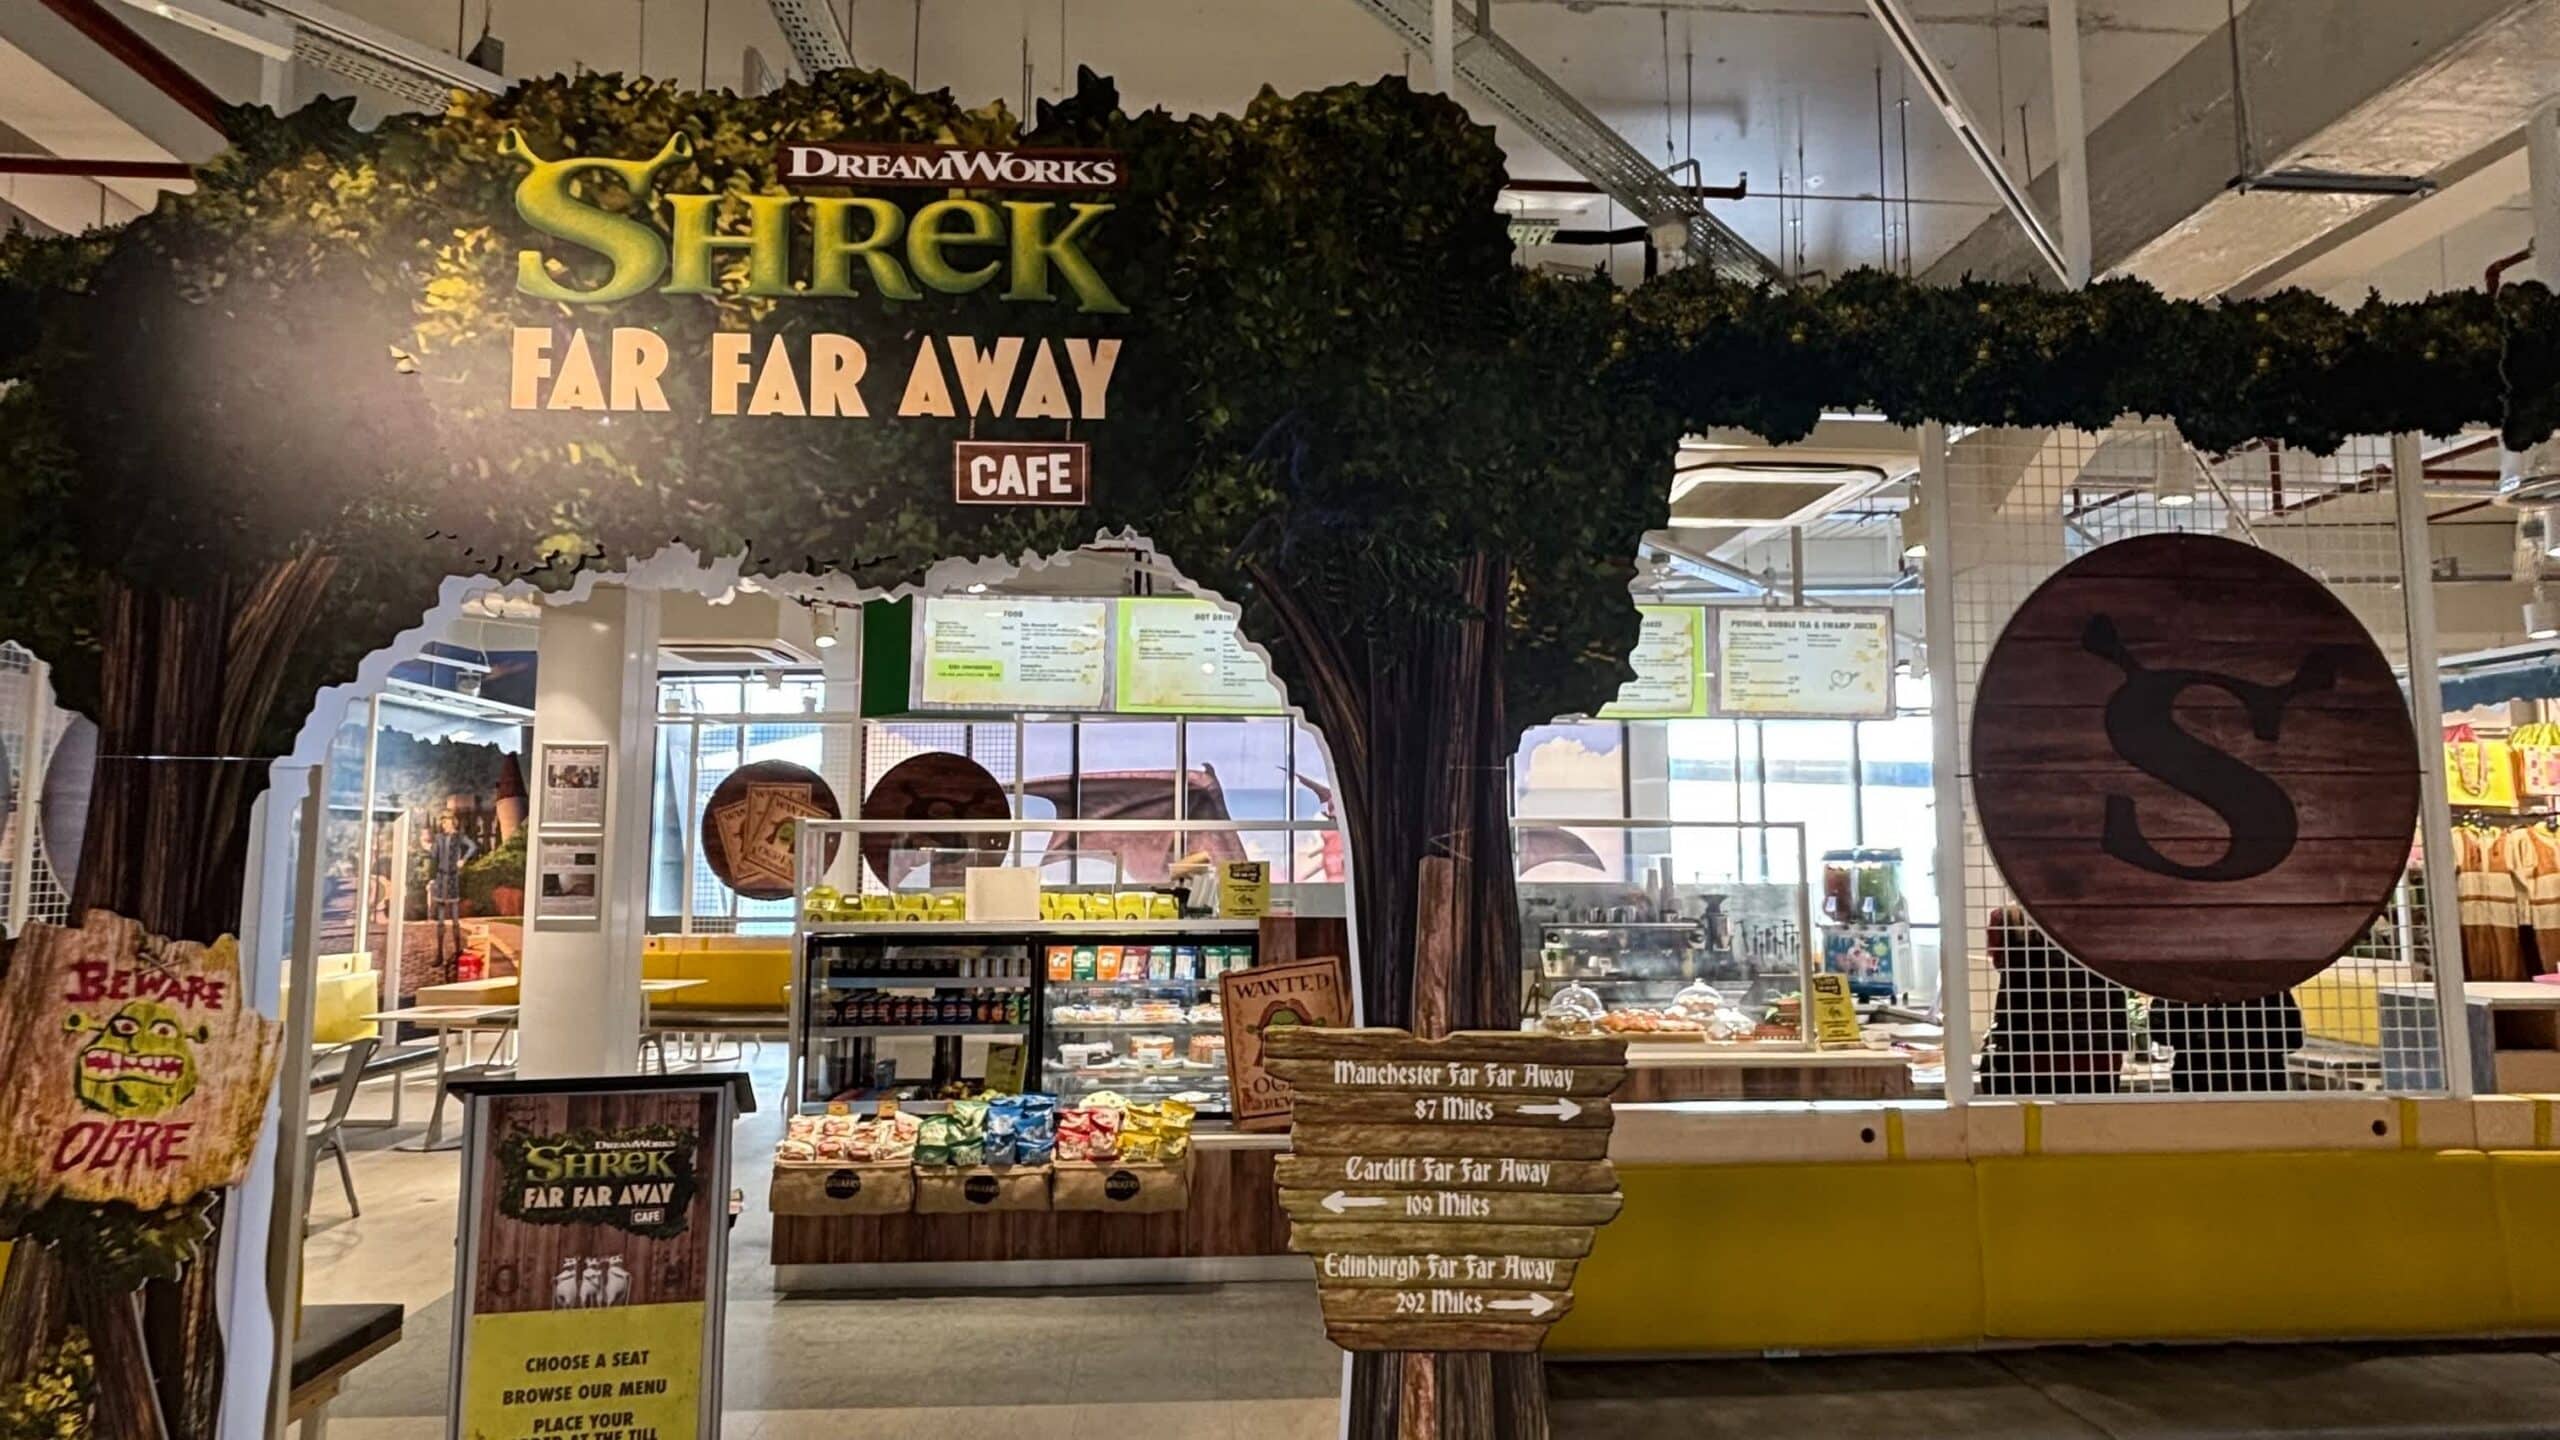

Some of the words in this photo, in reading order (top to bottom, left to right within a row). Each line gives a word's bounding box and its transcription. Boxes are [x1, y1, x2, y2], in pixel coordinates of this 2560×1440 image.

[786, 146, 1117, 187] DREAMWORKS
[511, 327, 670, 411] FAR
[711, 333, 868, 417] FAR
[898, 335, 1122, 420] AWAY
[970, 453, 1072, 496] CAFE
[2081, 613, 2338, 882] S
[65, 960, 227, 1010] BEWARE
[1232, 973, 1330, 999] WANTED
[1253, 1076, 1289, 1094] OG
[1334, 1060, 1442, 1085] Manchester
[1448, 1062, 1479, 1087] Far
[1484, 1063, 1517, 1087] Far
[1521, 1063, 1575, 1092] Away
[1415, 1099, 1438, 1120] 87
[1443, 1096, 1494, 1121] Miles
[51, 1120, 195, 1175] OGRE
[595, 1140, 677, 1150] DREAMWORKS
[1345, 1156, 1416, 1181] Cardiff
[1423, 1156, 1455, 1182] Far
[1460, 1157, 1492, 1183] Far
[1498, 1158, 1550, 1187] Away
[524, 1187, 565, 1209] FAR
[572, 1186, 613, 1208] FAR
[618, 1183, 675, 1205] AWAY
[1406, 1195, 1433, 1216] 109
[1438, 1192, 1490, 1217] Miles
[634, 1210, 661, 1223] CAFE
[1324, 1252, 1420, 1281] Edinburgh
[1426, 1254, 1458, 1281] Far
[1464, 1254, 1496, 1281] Far
[1502, 1255, 1556, 1284] Away
[1396, 1293, 1425, 1314] 292
[1432, 1290, 1484, 1315] Miles
[526, 1354, 590, 1373] CHOOSE
[594, 1354, 606, 1368] A
[612, 1350, 650, 1367] SEAT
[502, 1386, 572, 1406] BROWSE
[578, 1383, 612, 1399] OUR
[619, 1379, 668, 1397] MENU
[533, 1416, 584, 1433] PLACE
[589, 1412, 634, 1429] YOUR
[628, 1428, 657, 1440] TILL
